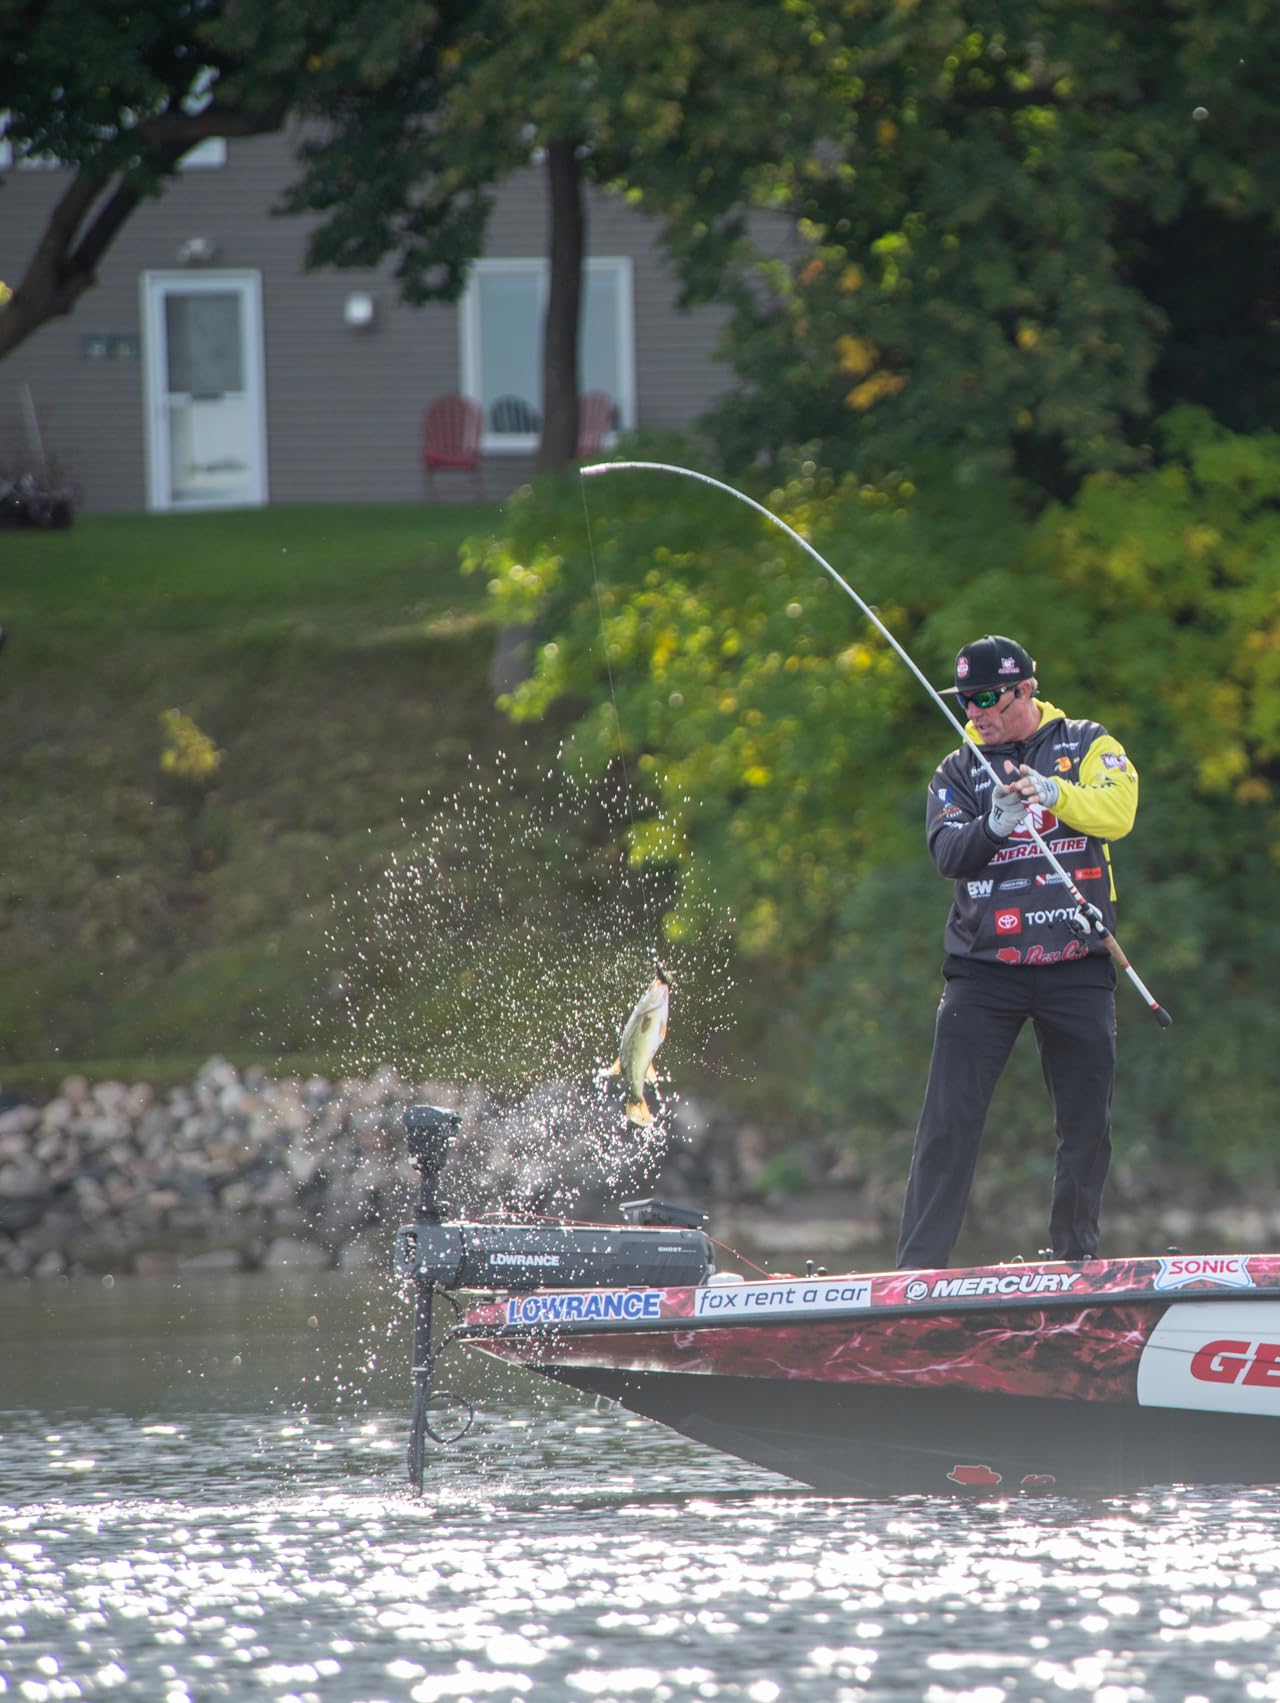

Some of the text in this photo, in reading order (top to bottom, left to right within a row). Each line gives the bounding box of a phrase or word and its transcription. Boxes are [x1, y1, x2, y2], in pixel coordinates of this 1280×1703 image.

[1050, 839, 1086, 853] TIRE
[967, 880, 993, 895] BW
[1025, 907, 1076, 925] TOYOT
[489, 1254, 560, 1267] LOWRANCE
[1168, 1259, 1240, 1275] SONIC
[930, 1272, 1082, 1298] MERCURY
[507, 1292, 664, 1325] LOWRANCE
[700, 1286, 868, 1314] fox rent a car
